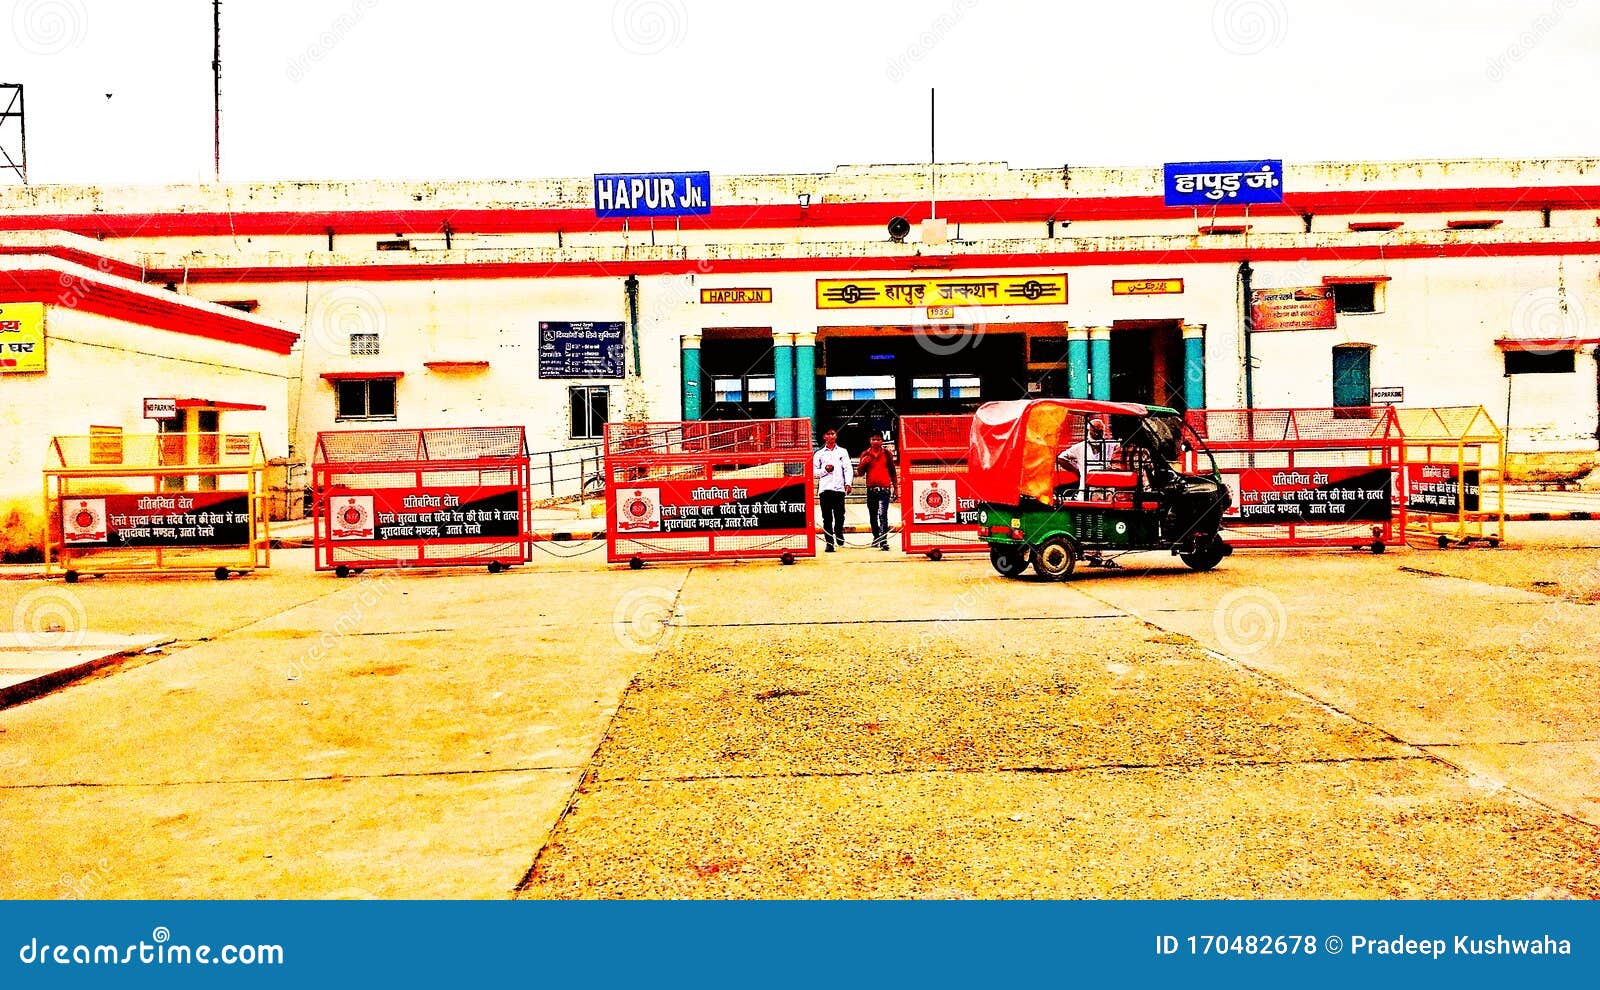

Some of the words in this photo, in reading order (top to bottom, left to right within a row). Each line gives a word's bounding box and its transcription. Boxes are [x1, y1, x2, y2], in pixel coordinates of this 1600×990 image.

[1174, 173, 1242, 200] हापुड़
[1244, 165, 1279, 189] जं.
[598, 178, 676, 210] HAPUR
[710, 291, 745, 302] HAPUR
[885, 284, 927, 304] हापुड़
[931, 308, 949, 316] 1936
[8, 343, 35, 353] घर
[1241, 489, 1258, 502] रेलवे
[1316, 488, 1327, 500] रेल
[1329, 488, 1340, 501] की
[1341, 488, 1355, 500] सेवा
[660, 504, 677, 516] रेलवे
[738, 502, 750, 514] रेल
[751, 501, 762, 514] की
[763, 501, 778, 514] सेवा
[1242, 504, 1275, 517] मुरादाबाद
[1309, 503, 1327, 514] उत्तर
[110, 513, 127, 526] रेलवे
[185, 512, 196, 524] रेल
[198, 511, 209, 524] की
[210, 512, 223, 524] सेवा
[378, 512, 395, 524] रेलवे
[452, 509, 464, 521] रेल
[466, 509, 476, 522] की
[478, 509, 492, 521] सेवा
[742, 515, 759, 528] रेलवे
[198, 524, 215, 537] रेलवे
[380, 526, 413, 539] मुरादाबाद
[445, 525, 462, 535] उत्तर
[464, 522, 481, 535] रेलवे
